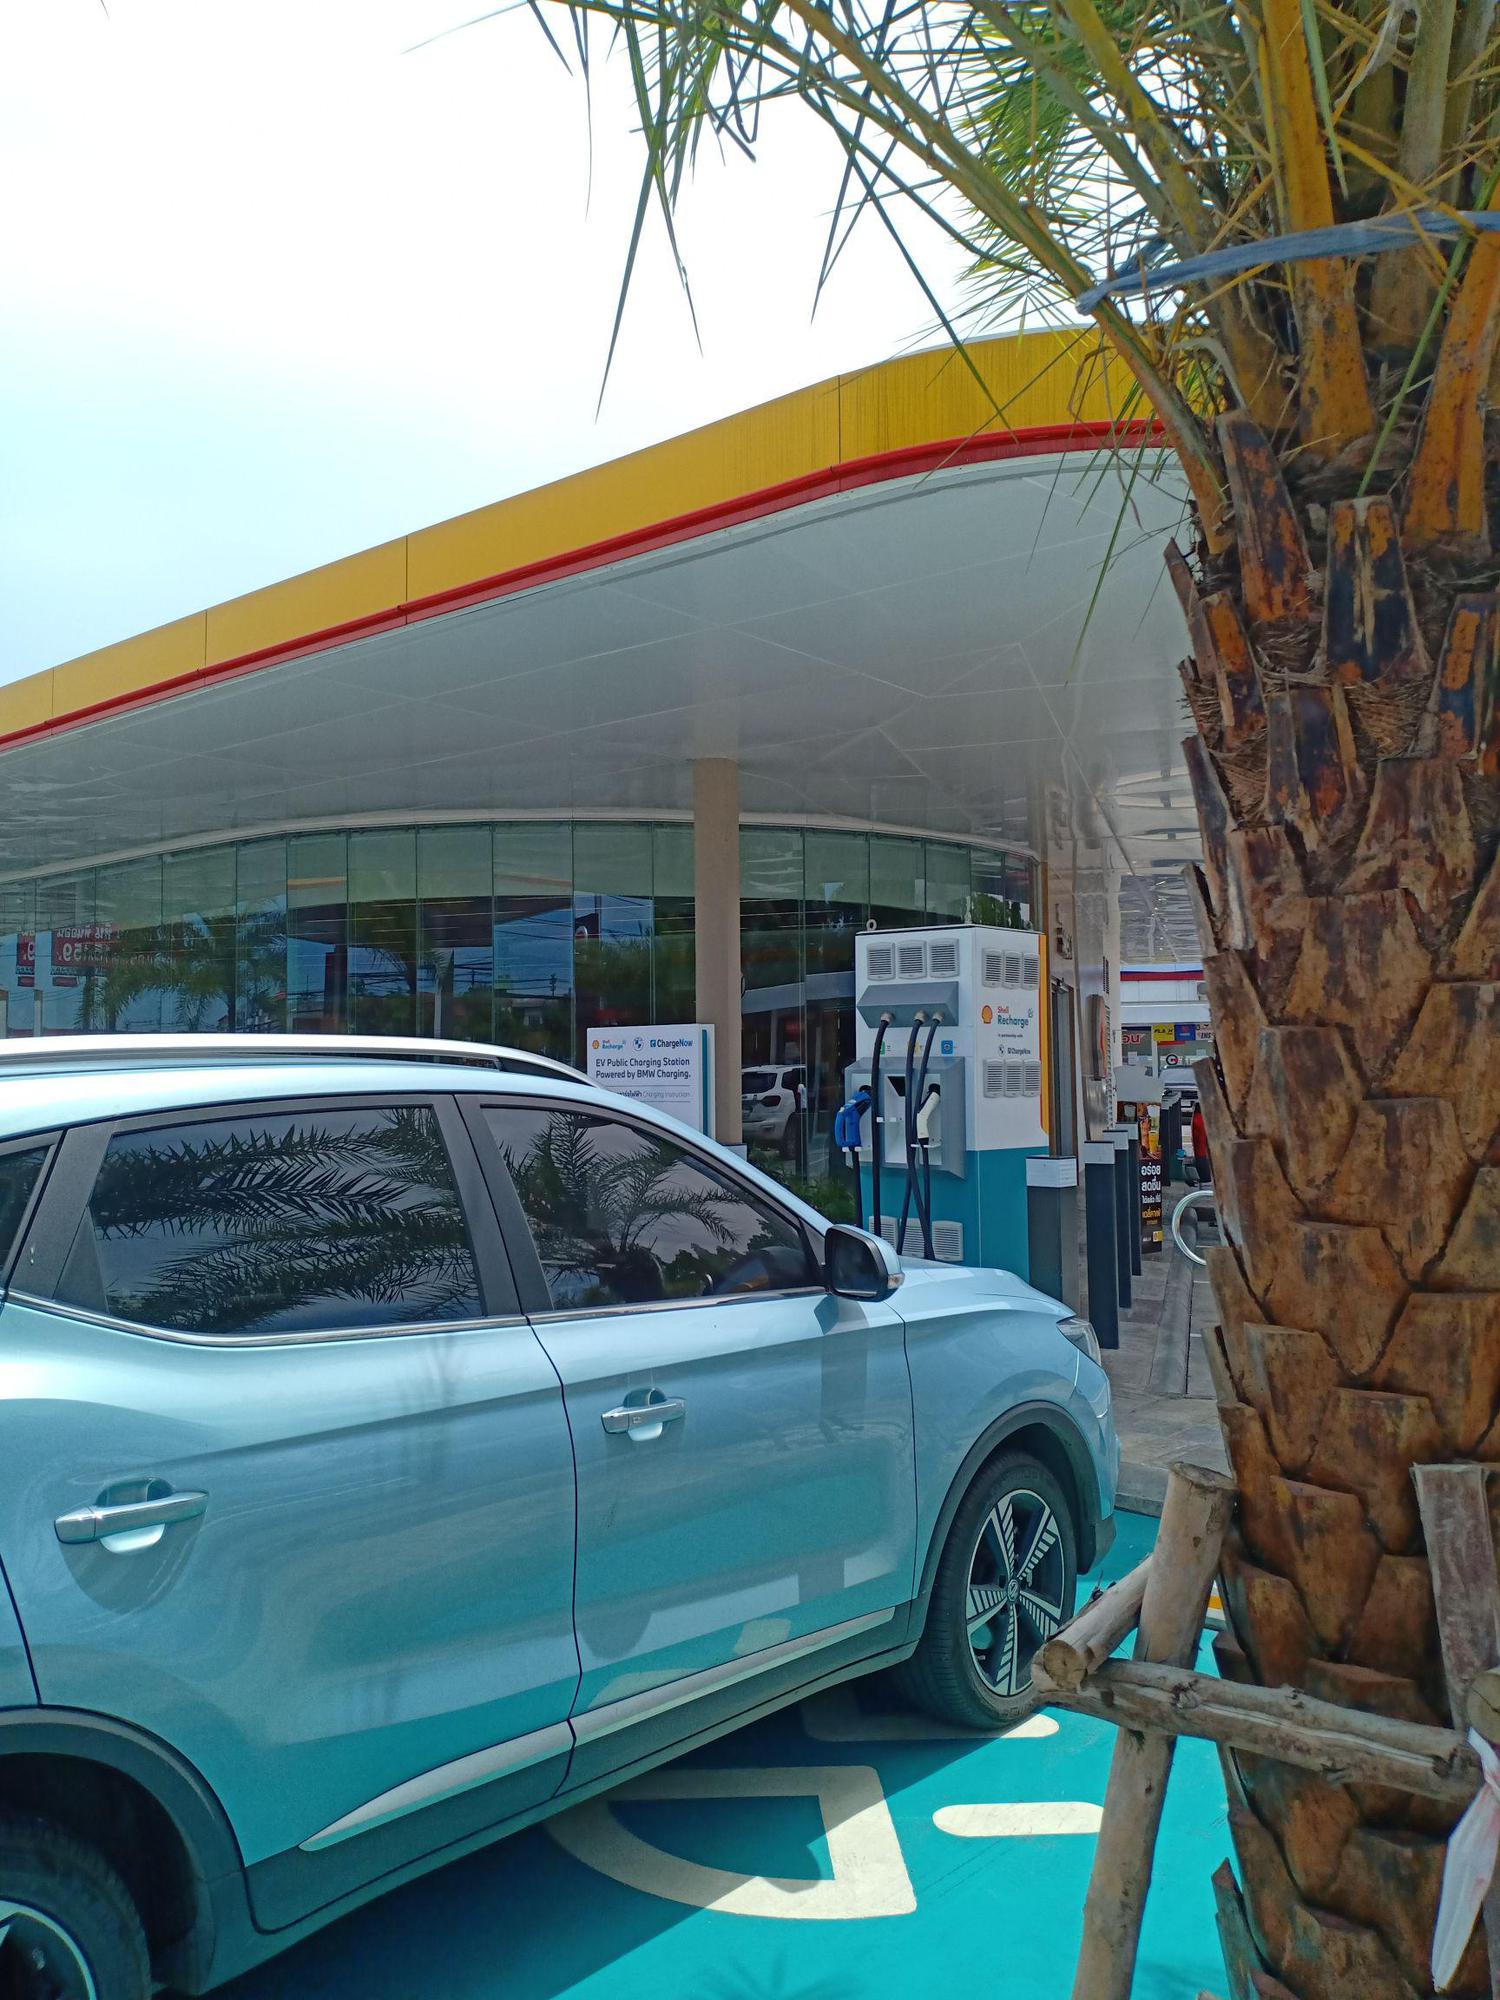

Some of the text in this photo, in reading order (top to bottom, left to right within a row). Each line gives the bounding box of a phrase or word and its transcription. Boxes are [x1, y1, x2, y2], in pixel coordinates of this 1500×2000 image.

[997, 1015, 1029, 1028] Recharge
[657, 1039, 692, 1049] ChargeNow
[596, 1057, 690, 1068] EV Public Charging Station
[596, 1069, 691, 1080] Powered by BMW Charging.
[1141, 1162, 1161, 1176] อร่อย
[1141, 1176, 1161, 1192] สดชื่น
